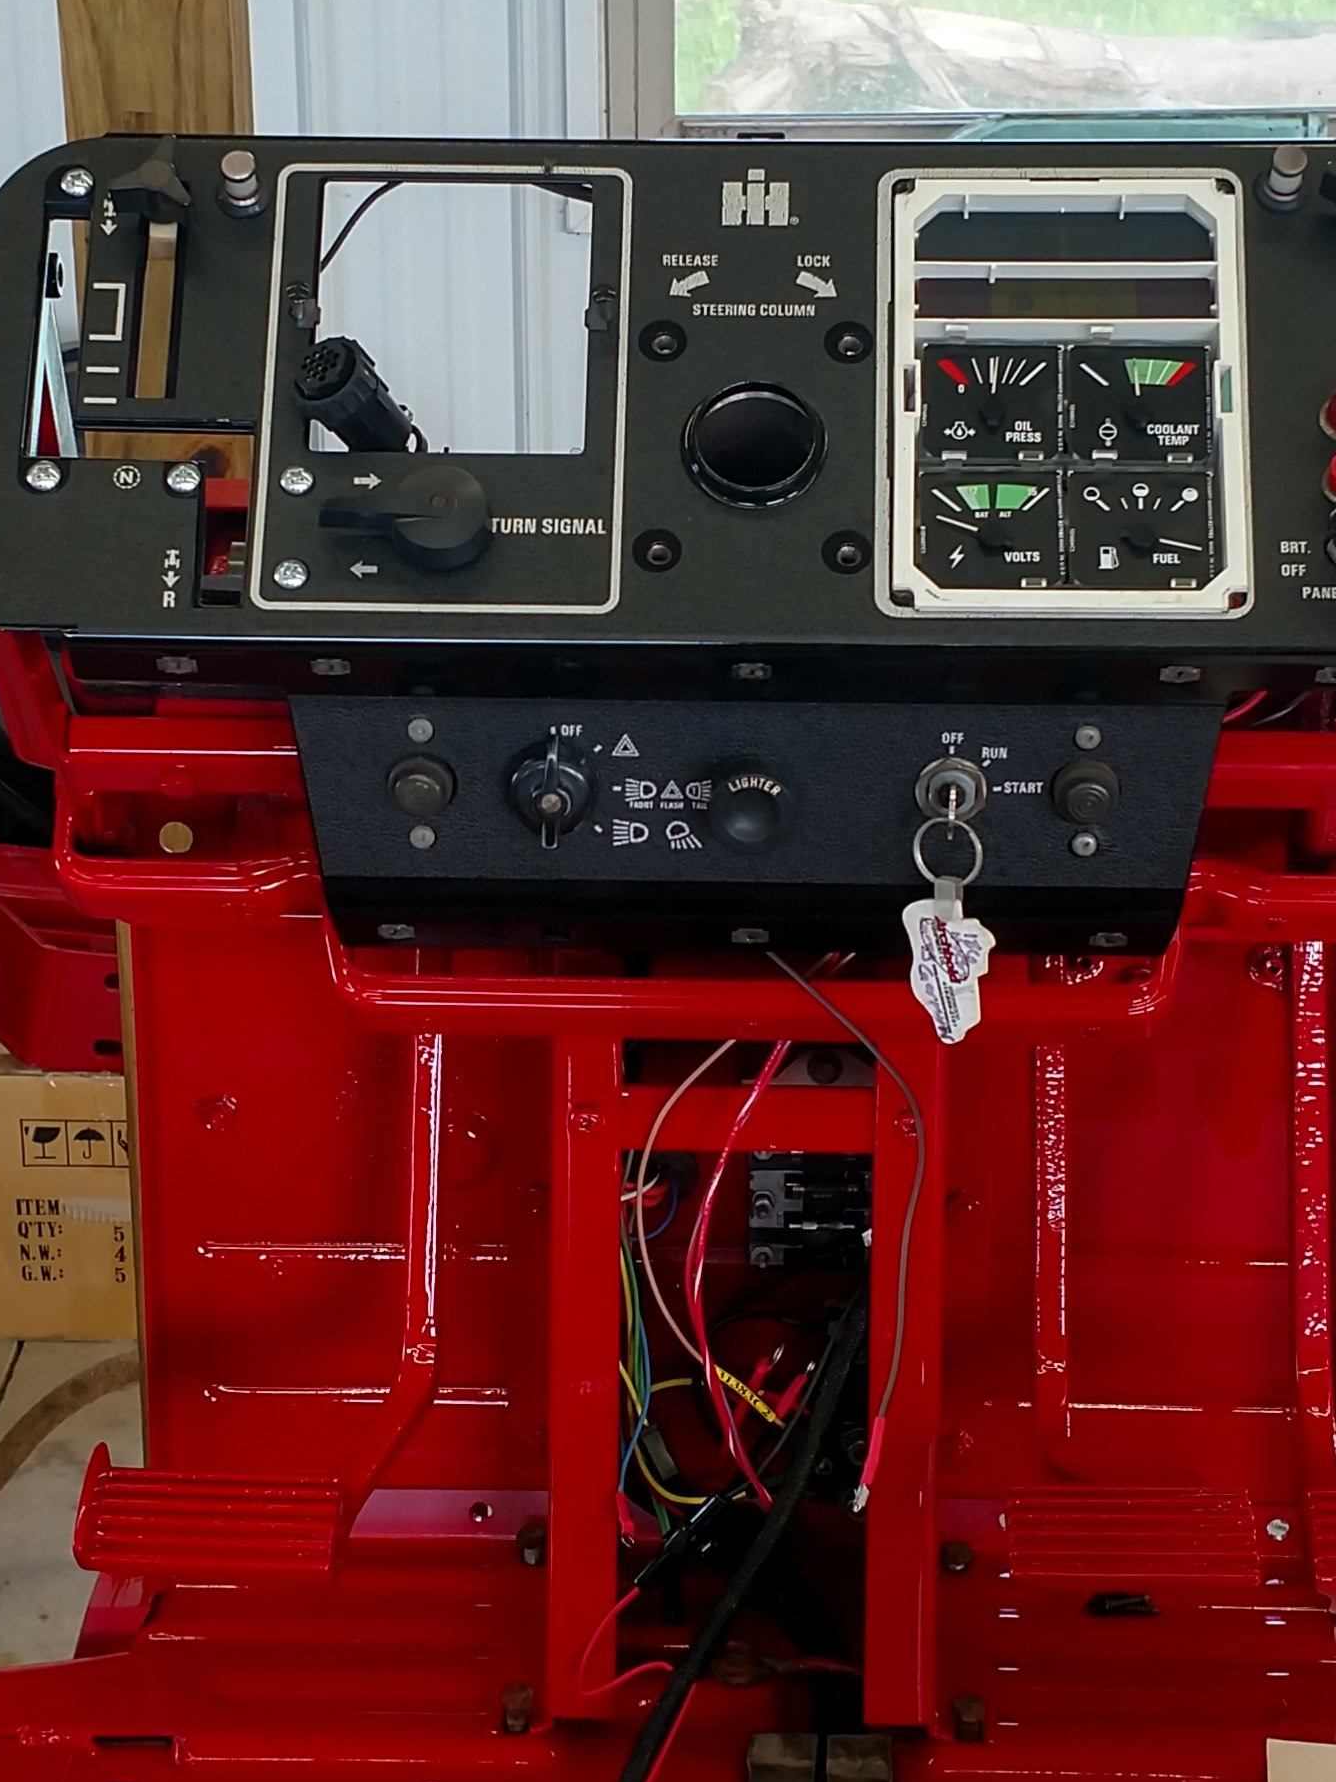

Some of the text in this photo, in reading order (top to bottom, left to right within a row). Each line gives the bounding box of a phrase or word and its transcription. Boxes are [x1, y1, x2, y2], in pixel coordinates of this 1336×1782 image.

[662, 254, 719, 267] RELEASE
[797, 254, 831, 268] LOCK
[692, 303, 816, 317] STEERING COLUMN
[1014, 421, 1033, 432] OIL
[1146, 424, 1201, 435] COOLANT
[1005, 432, 1042, 443] PRESS
[1157, 435, 1190, 446] TEMP
[119, 471, 134, 484] N
[974, 511, 989, 519] BAT
[998, 510, 1012, 518] ALT
[491, 517, 607, 535] TURN SIGNAL
[1280, 541, 1311, 554] BRT.
[1004, 551, 1041, 563] VOLTS
[1152, 553, 1181, 564] FUEL
[1280, 564, 1307, 577] OFF
[162, 590, 176, 608] R
[560, 724, 583, 737] OFF
[941, 731, 964, 745] OFF
[981, 746, 1008, 759] RUN
[728, 776, 782, 797] LIGHTER
[1003, 781, 1044, 794] START
[17, 1221, 63, 1240] Q'TY:
